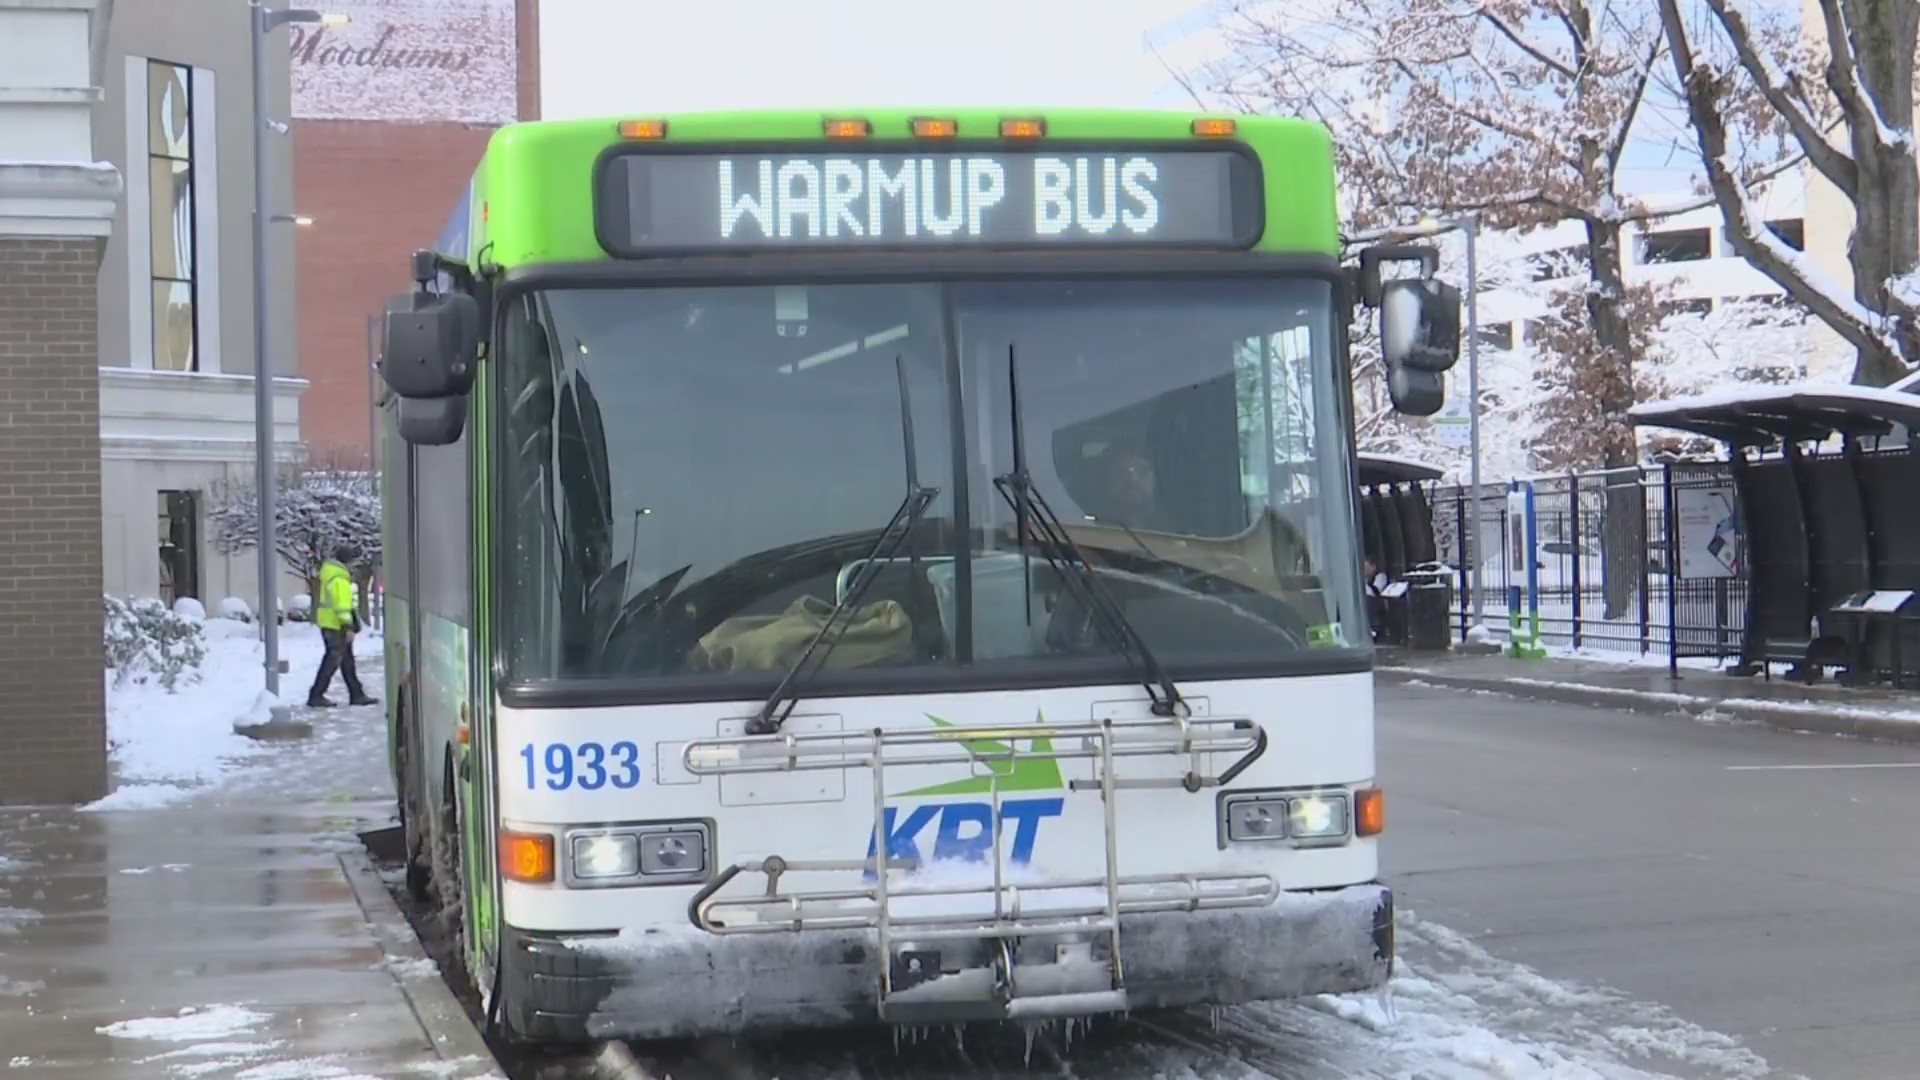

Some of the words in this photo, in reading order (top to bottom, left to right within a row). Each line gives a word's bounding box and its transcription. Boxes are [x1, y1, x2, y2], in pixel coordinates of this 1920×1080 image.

[718, 158, 1006, 239] WARMUP
[1034, 156, 1160, 235] BUS
[520, 741, 640, 791] 1933
